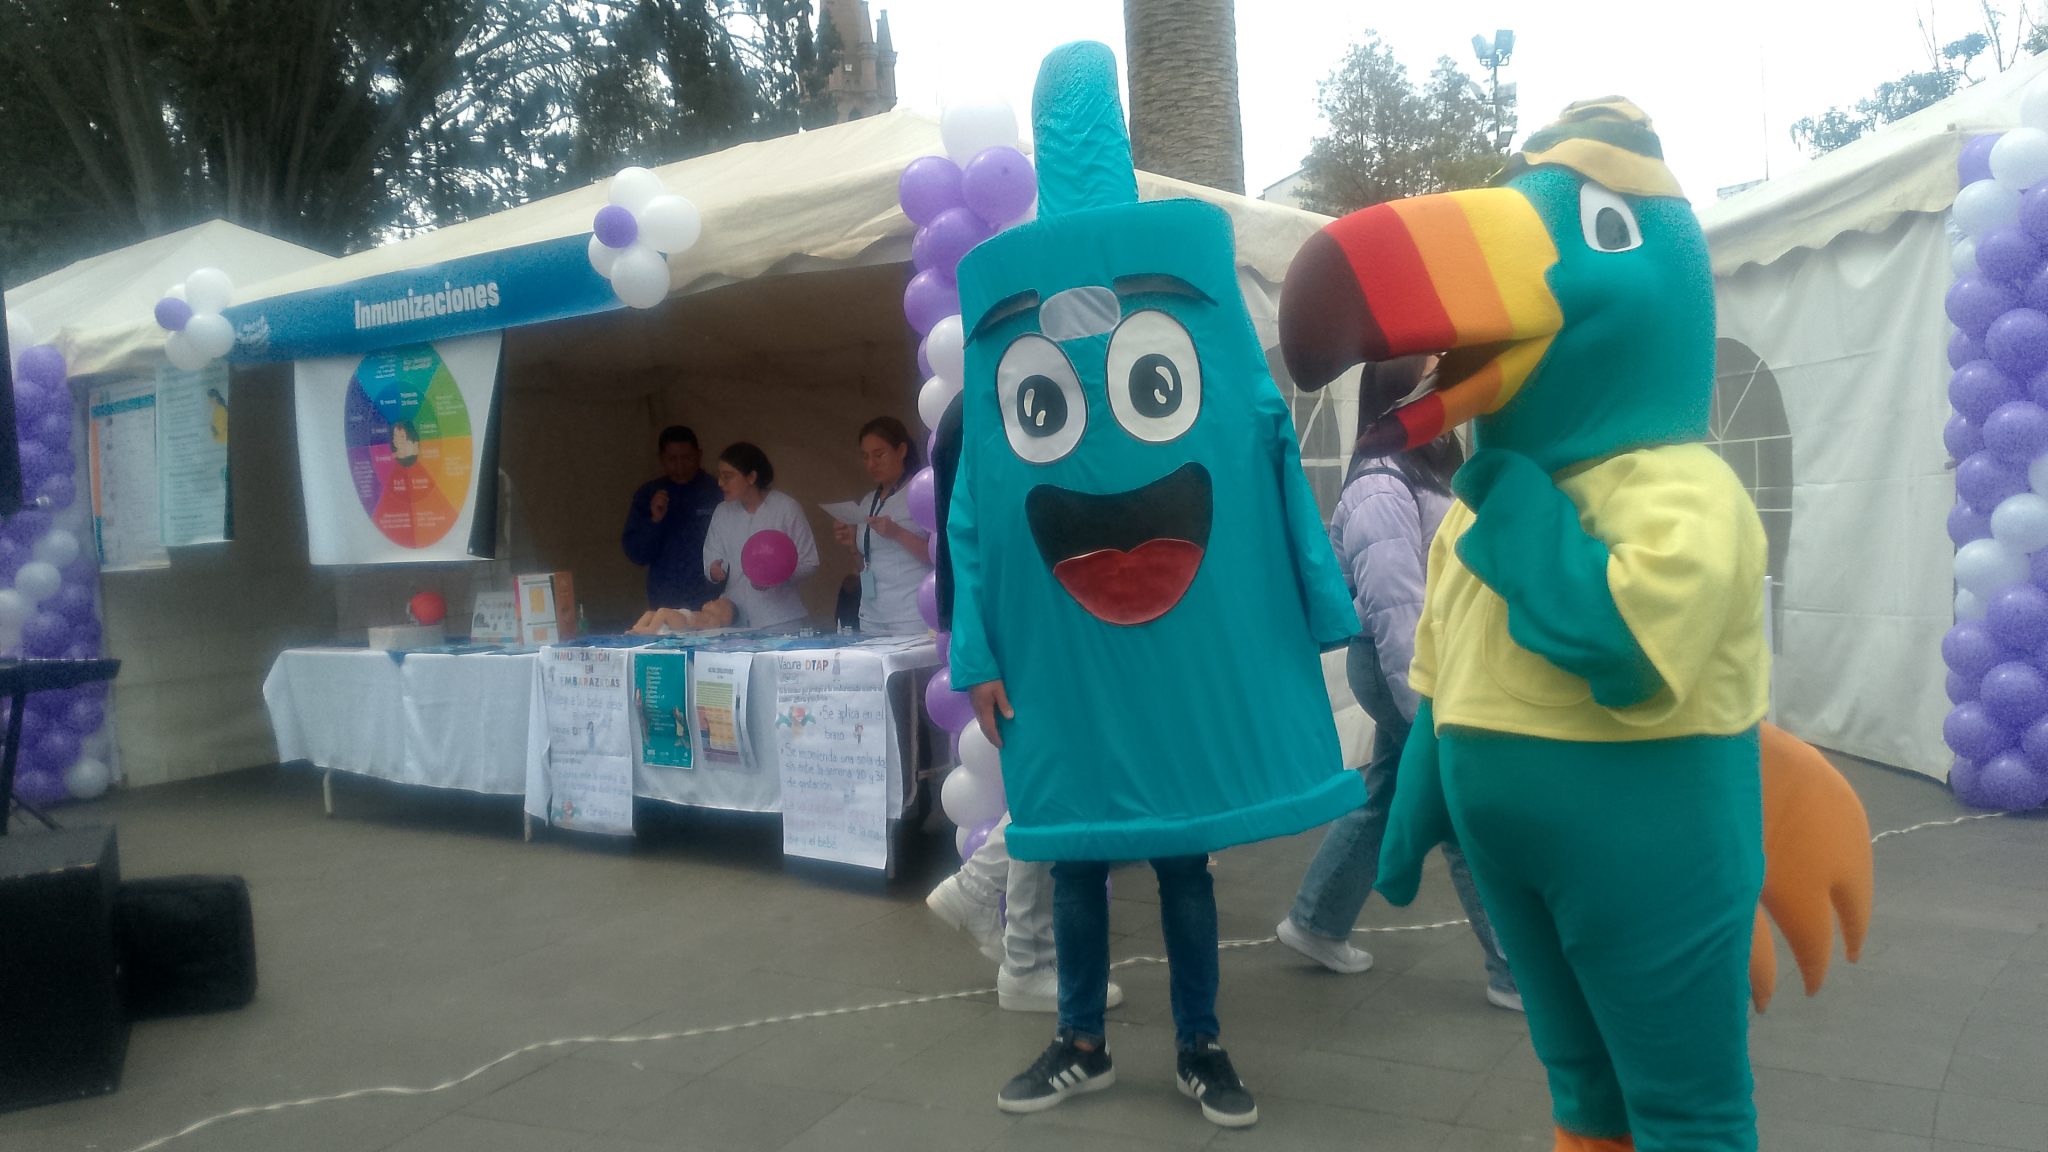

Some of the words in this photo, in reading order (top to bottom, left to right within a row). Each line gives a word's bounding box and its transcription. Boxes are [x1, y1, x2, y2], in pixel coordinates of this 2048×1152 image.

[355, 281, 499, 329] Inmunizaciones
[778, 656, 801, 670] Vacuna
[805, 660, 829, 672] DTAP
[822, 705, 834, 720] Se
[837, 703, 860, 724] aplica
